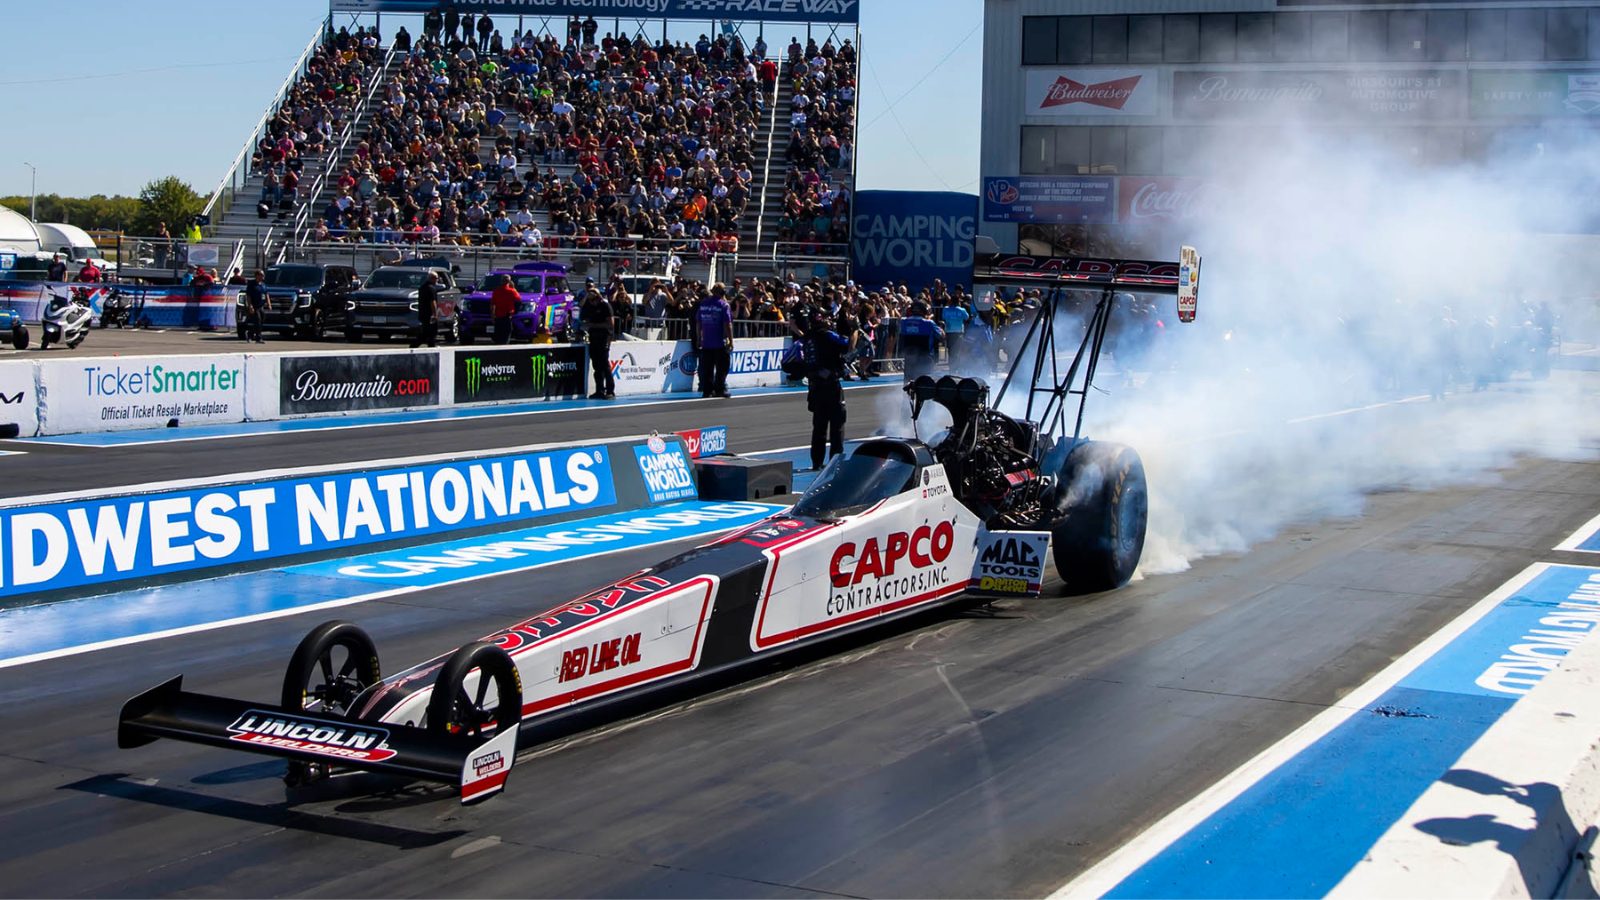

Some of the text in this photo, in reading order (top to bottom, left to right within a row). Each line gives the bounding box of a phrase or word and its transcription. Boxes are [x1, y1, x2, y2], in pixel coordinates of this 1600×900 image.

[725, 0, 856, 14] RACEWAY
[1048, 82, 1132, 100] Budweiser
[1351, 89, 1439, 100] AUTOMOTIVE
[854, 214, 975, 239] CAMPING
[853, 239, 975, 267] WORLD
[1179, 296, 1196, 305] CAPCO
[84, 363, 240, 396] TicketSmarter
[291, 369, 430, 402] Bommarito .com
[101, 401, 228, 420] Official Ticket Resale Marketplace
[701, 429, 726, 442] CAMPING
[701, 440, 726, 453] WORLD
[639, 451, 685, 471] CAMPING
[644, 468, 691, 492] WORLD
[927, 484, 948, 498] TOYOTA
[337, 504, 770, 579] CAMPING WORLD
[829, 520, 954, 588] CAPCO
[980, 537, 1041, 567] MAC
[980, 564, 1040, 578] TOOLS
[558, 646, 589, 683] RED
[589, 637, 622, 675] LINE
[621, 632, 642, 666] OIL
[238, 715, 378, 749] LINCOLN
[249, 735, 372, 758] WELDERS
[474, 752, 500, 768] LINCOLN
[479, 761, 502, 775] WELDERS
